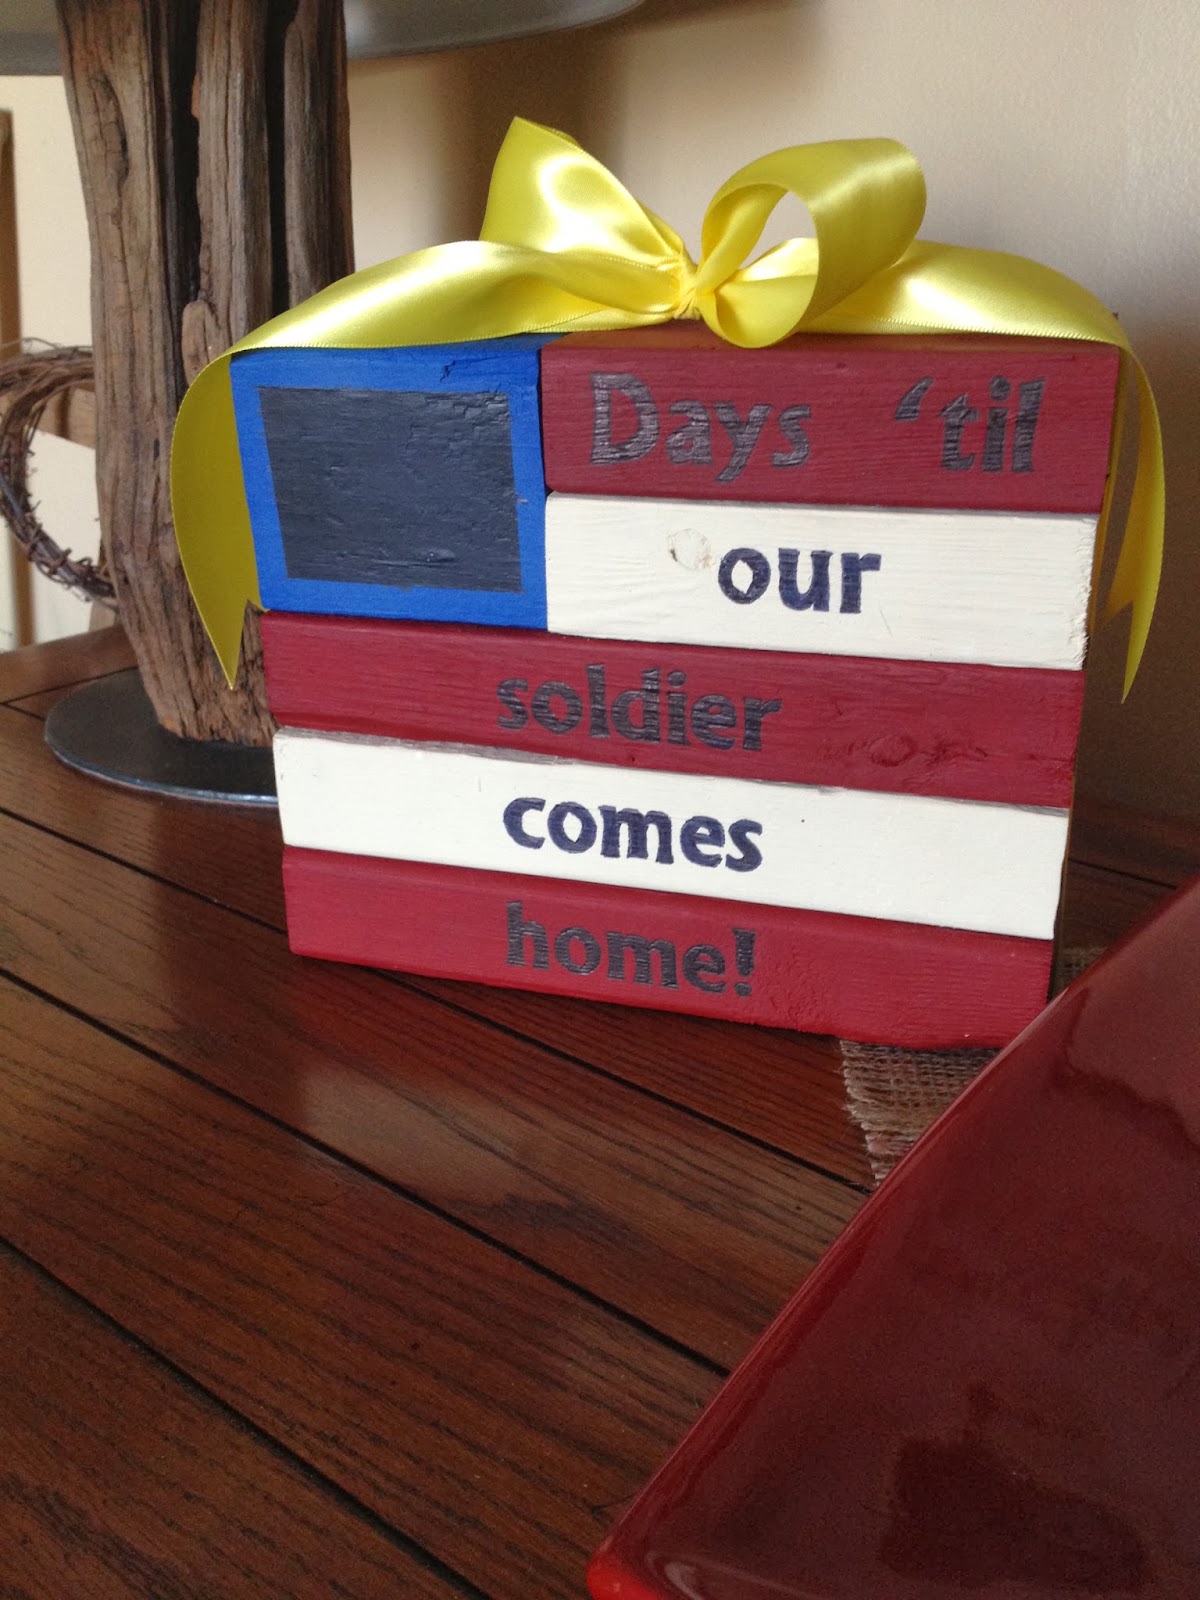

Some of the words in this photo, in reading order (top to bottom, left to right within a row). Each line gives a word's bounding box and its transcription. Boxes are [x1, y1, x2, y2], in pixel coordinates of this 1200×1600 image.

[589, 370, 812, 484] Days
[717, 546, 881, 614] our
[496, 663, 782, 751] soldier
[502, 796, 763, 873] comes
[505, 900, 757, 997] home!
